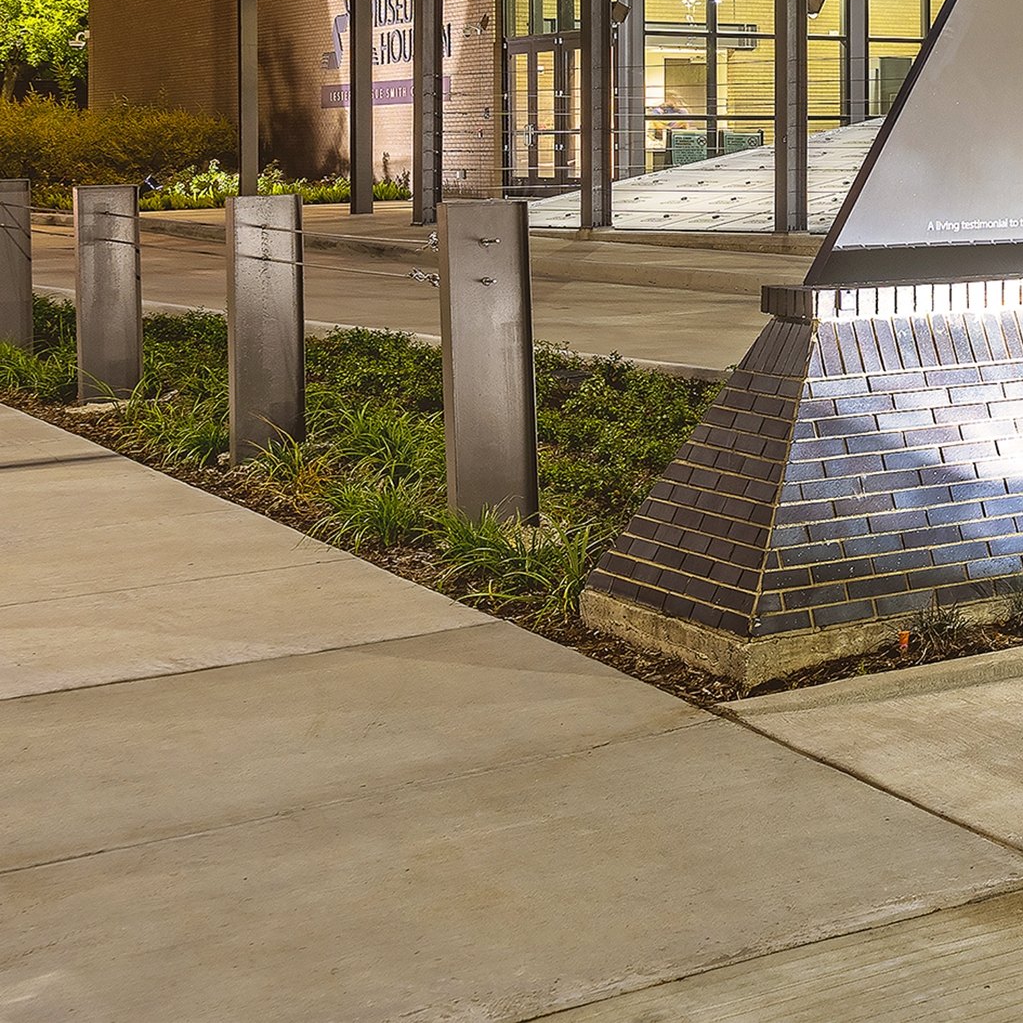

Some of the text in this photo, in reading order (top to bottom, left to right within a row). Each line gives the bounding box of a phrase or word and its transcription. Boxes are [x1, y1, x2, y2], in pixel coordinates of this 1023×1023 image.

[380, 22, 452, 65] HOUN
[927, 221, 935, 231] A
[935, 220, 960, 232] living
[960, 218, 1008, 230] testimonial
[1009, 219, 1019, 228] to
